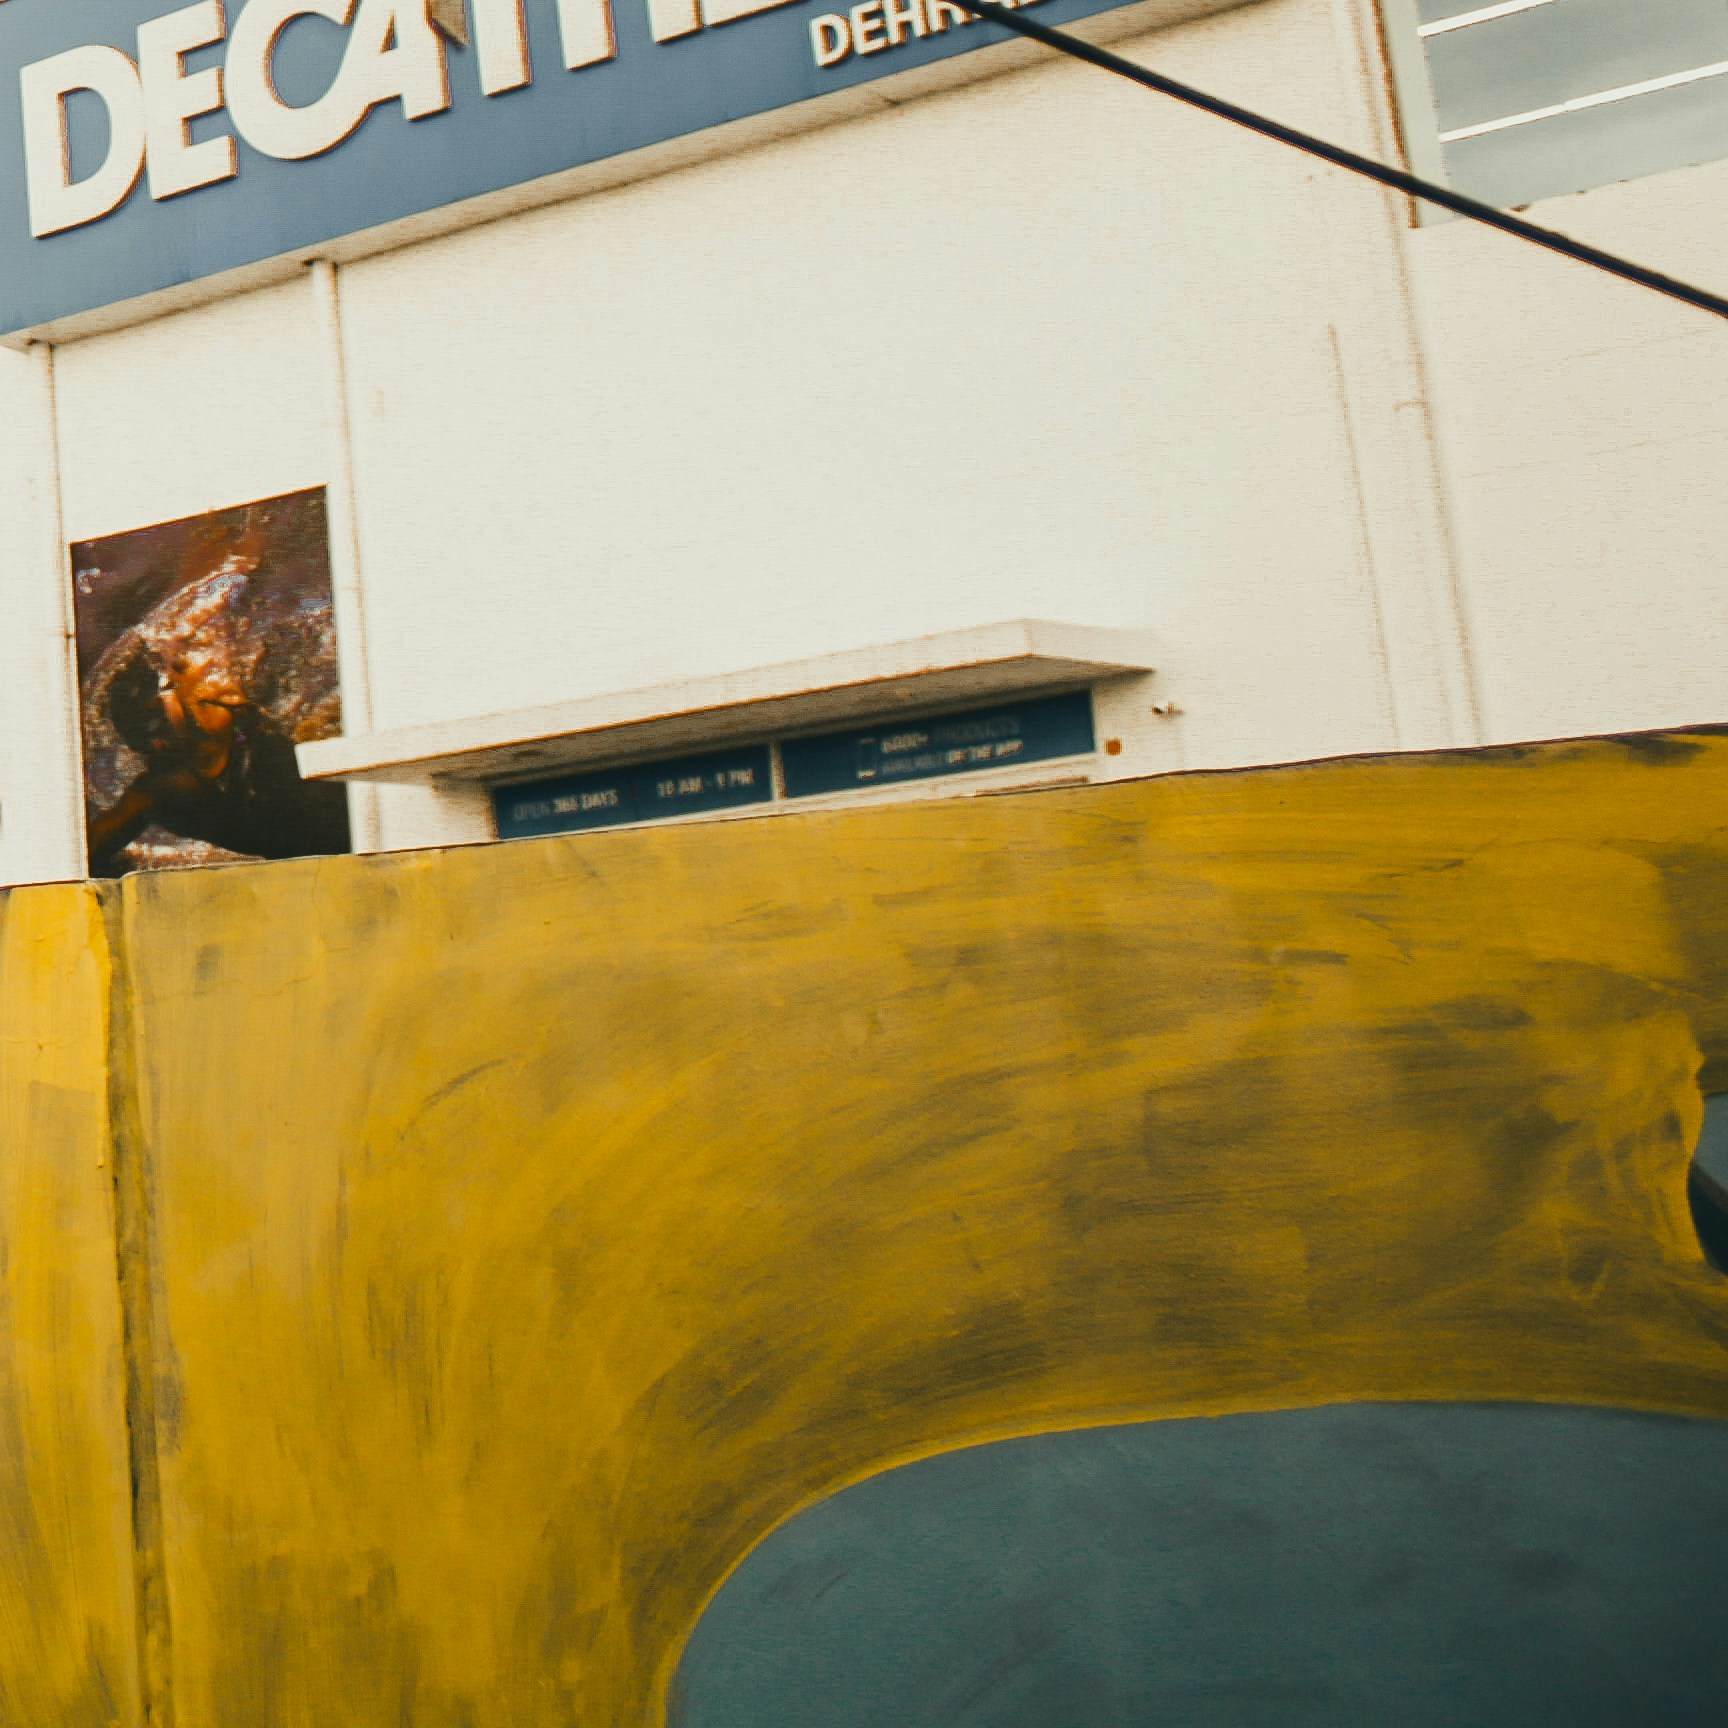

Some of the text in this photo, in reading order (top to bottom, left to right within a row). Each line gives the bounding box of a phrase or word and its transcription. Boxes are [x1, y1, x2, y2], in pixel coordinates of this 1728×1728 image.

[678, 776, 704, 795] AM
[728, 768, 755, 788] PM
[580, 788, 620, 810] DAYS
